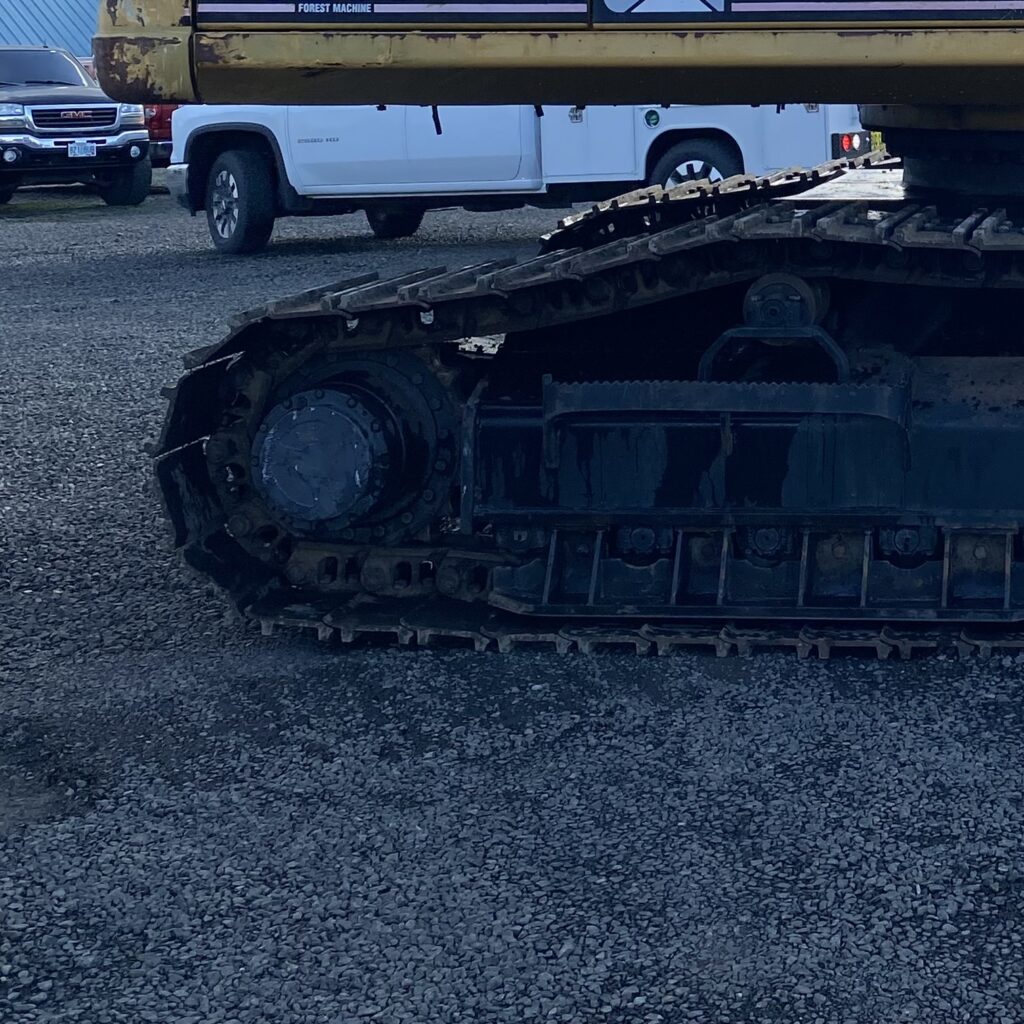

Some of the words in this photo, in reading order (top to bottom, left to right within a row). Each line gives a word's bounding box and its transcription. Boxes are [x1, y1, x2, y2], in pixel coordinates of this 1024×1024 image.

[298, 3, 331, 13] FOREST
[332, 3, 372, 13] MACHINE
[60, 110, 93, 119] GMC
